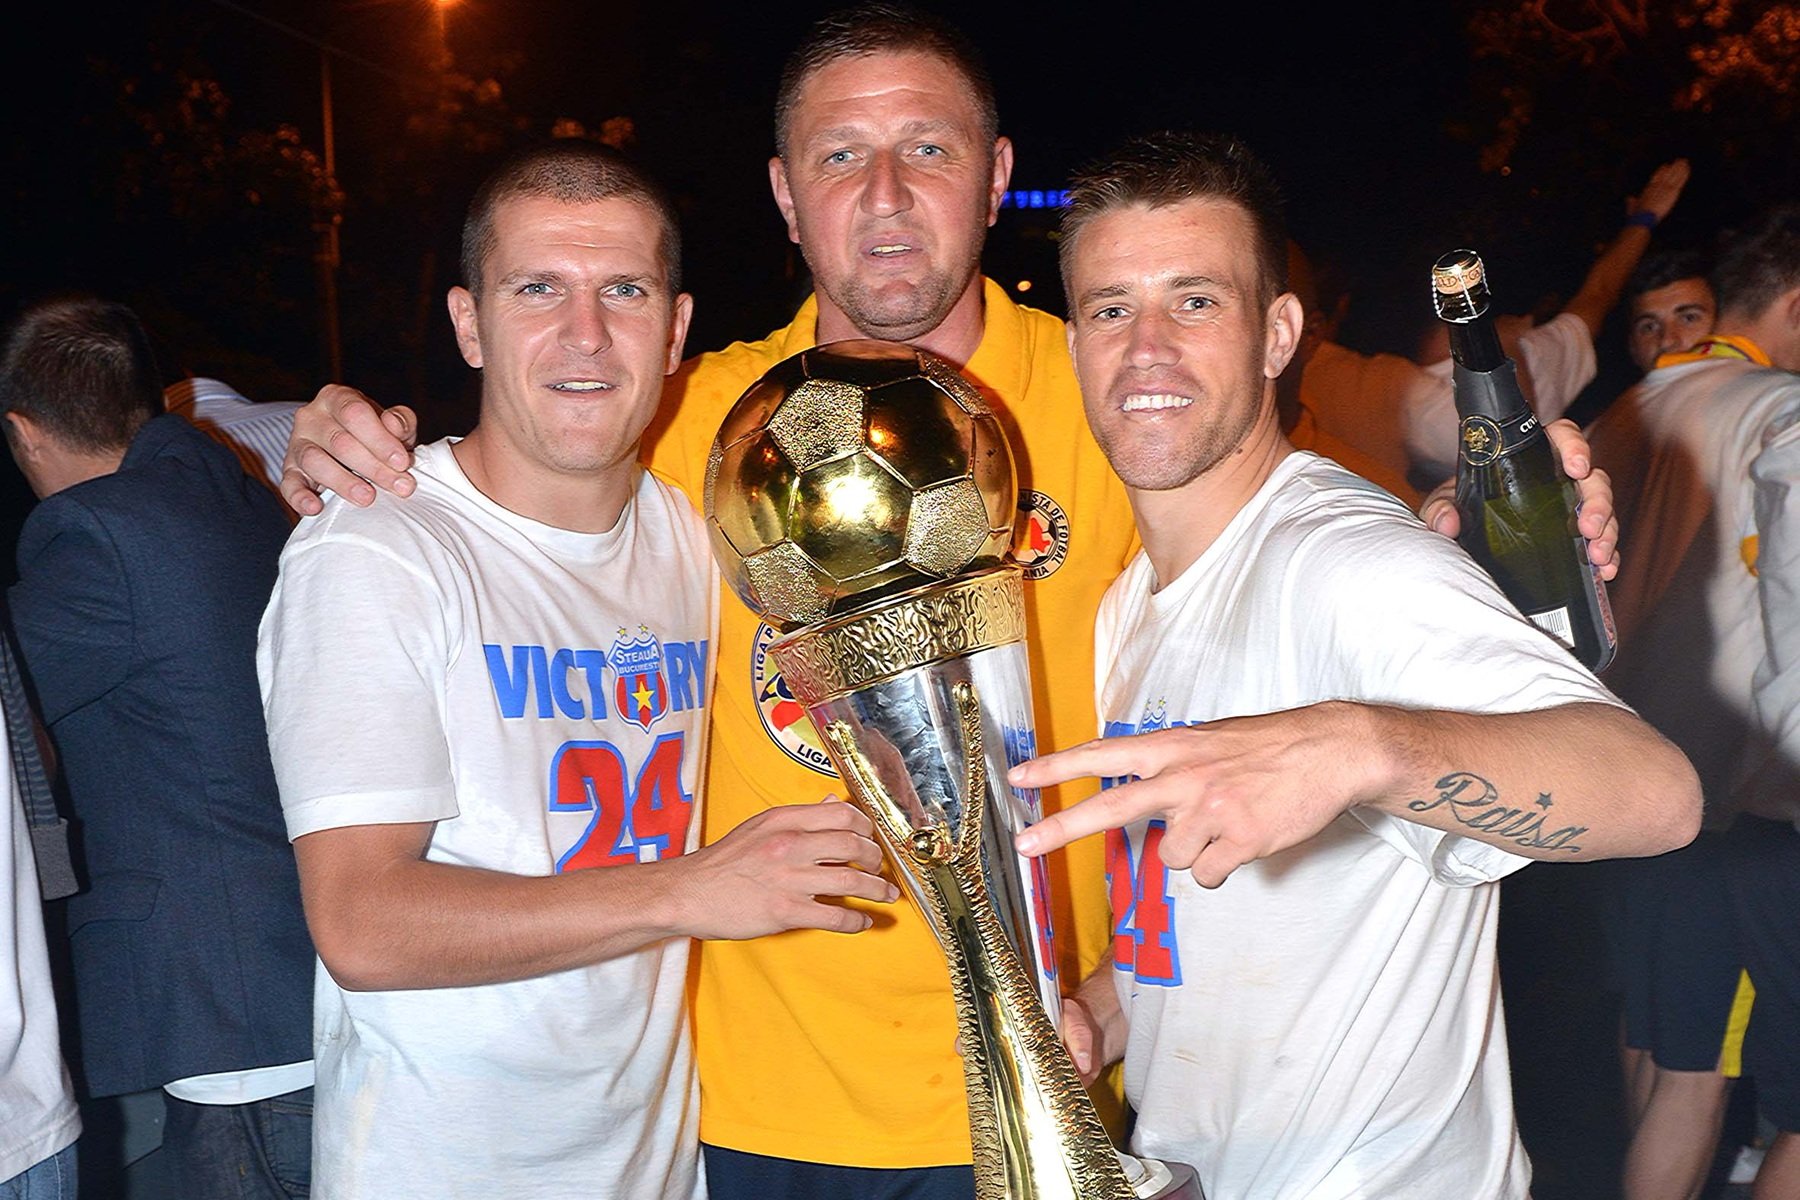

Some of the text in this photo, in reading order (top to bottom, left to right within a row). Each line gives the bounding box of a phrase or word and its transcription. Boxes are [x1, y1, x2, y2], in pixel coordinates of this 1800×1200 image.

[1019, 493, 1068, 565] NISTA DE FOTBAL
[1022, 565, 1050, 578] ANIA
[615, 644, 660, 664] STEAUA
[618, 661, 660, 674] BUCUREST
[756, 627, 774, 681] LIGA P
[797, 743, 832, 768] LIGA
[549, 731, 693, 875] 24
[1408, 771, 1590, 853] Raisa
